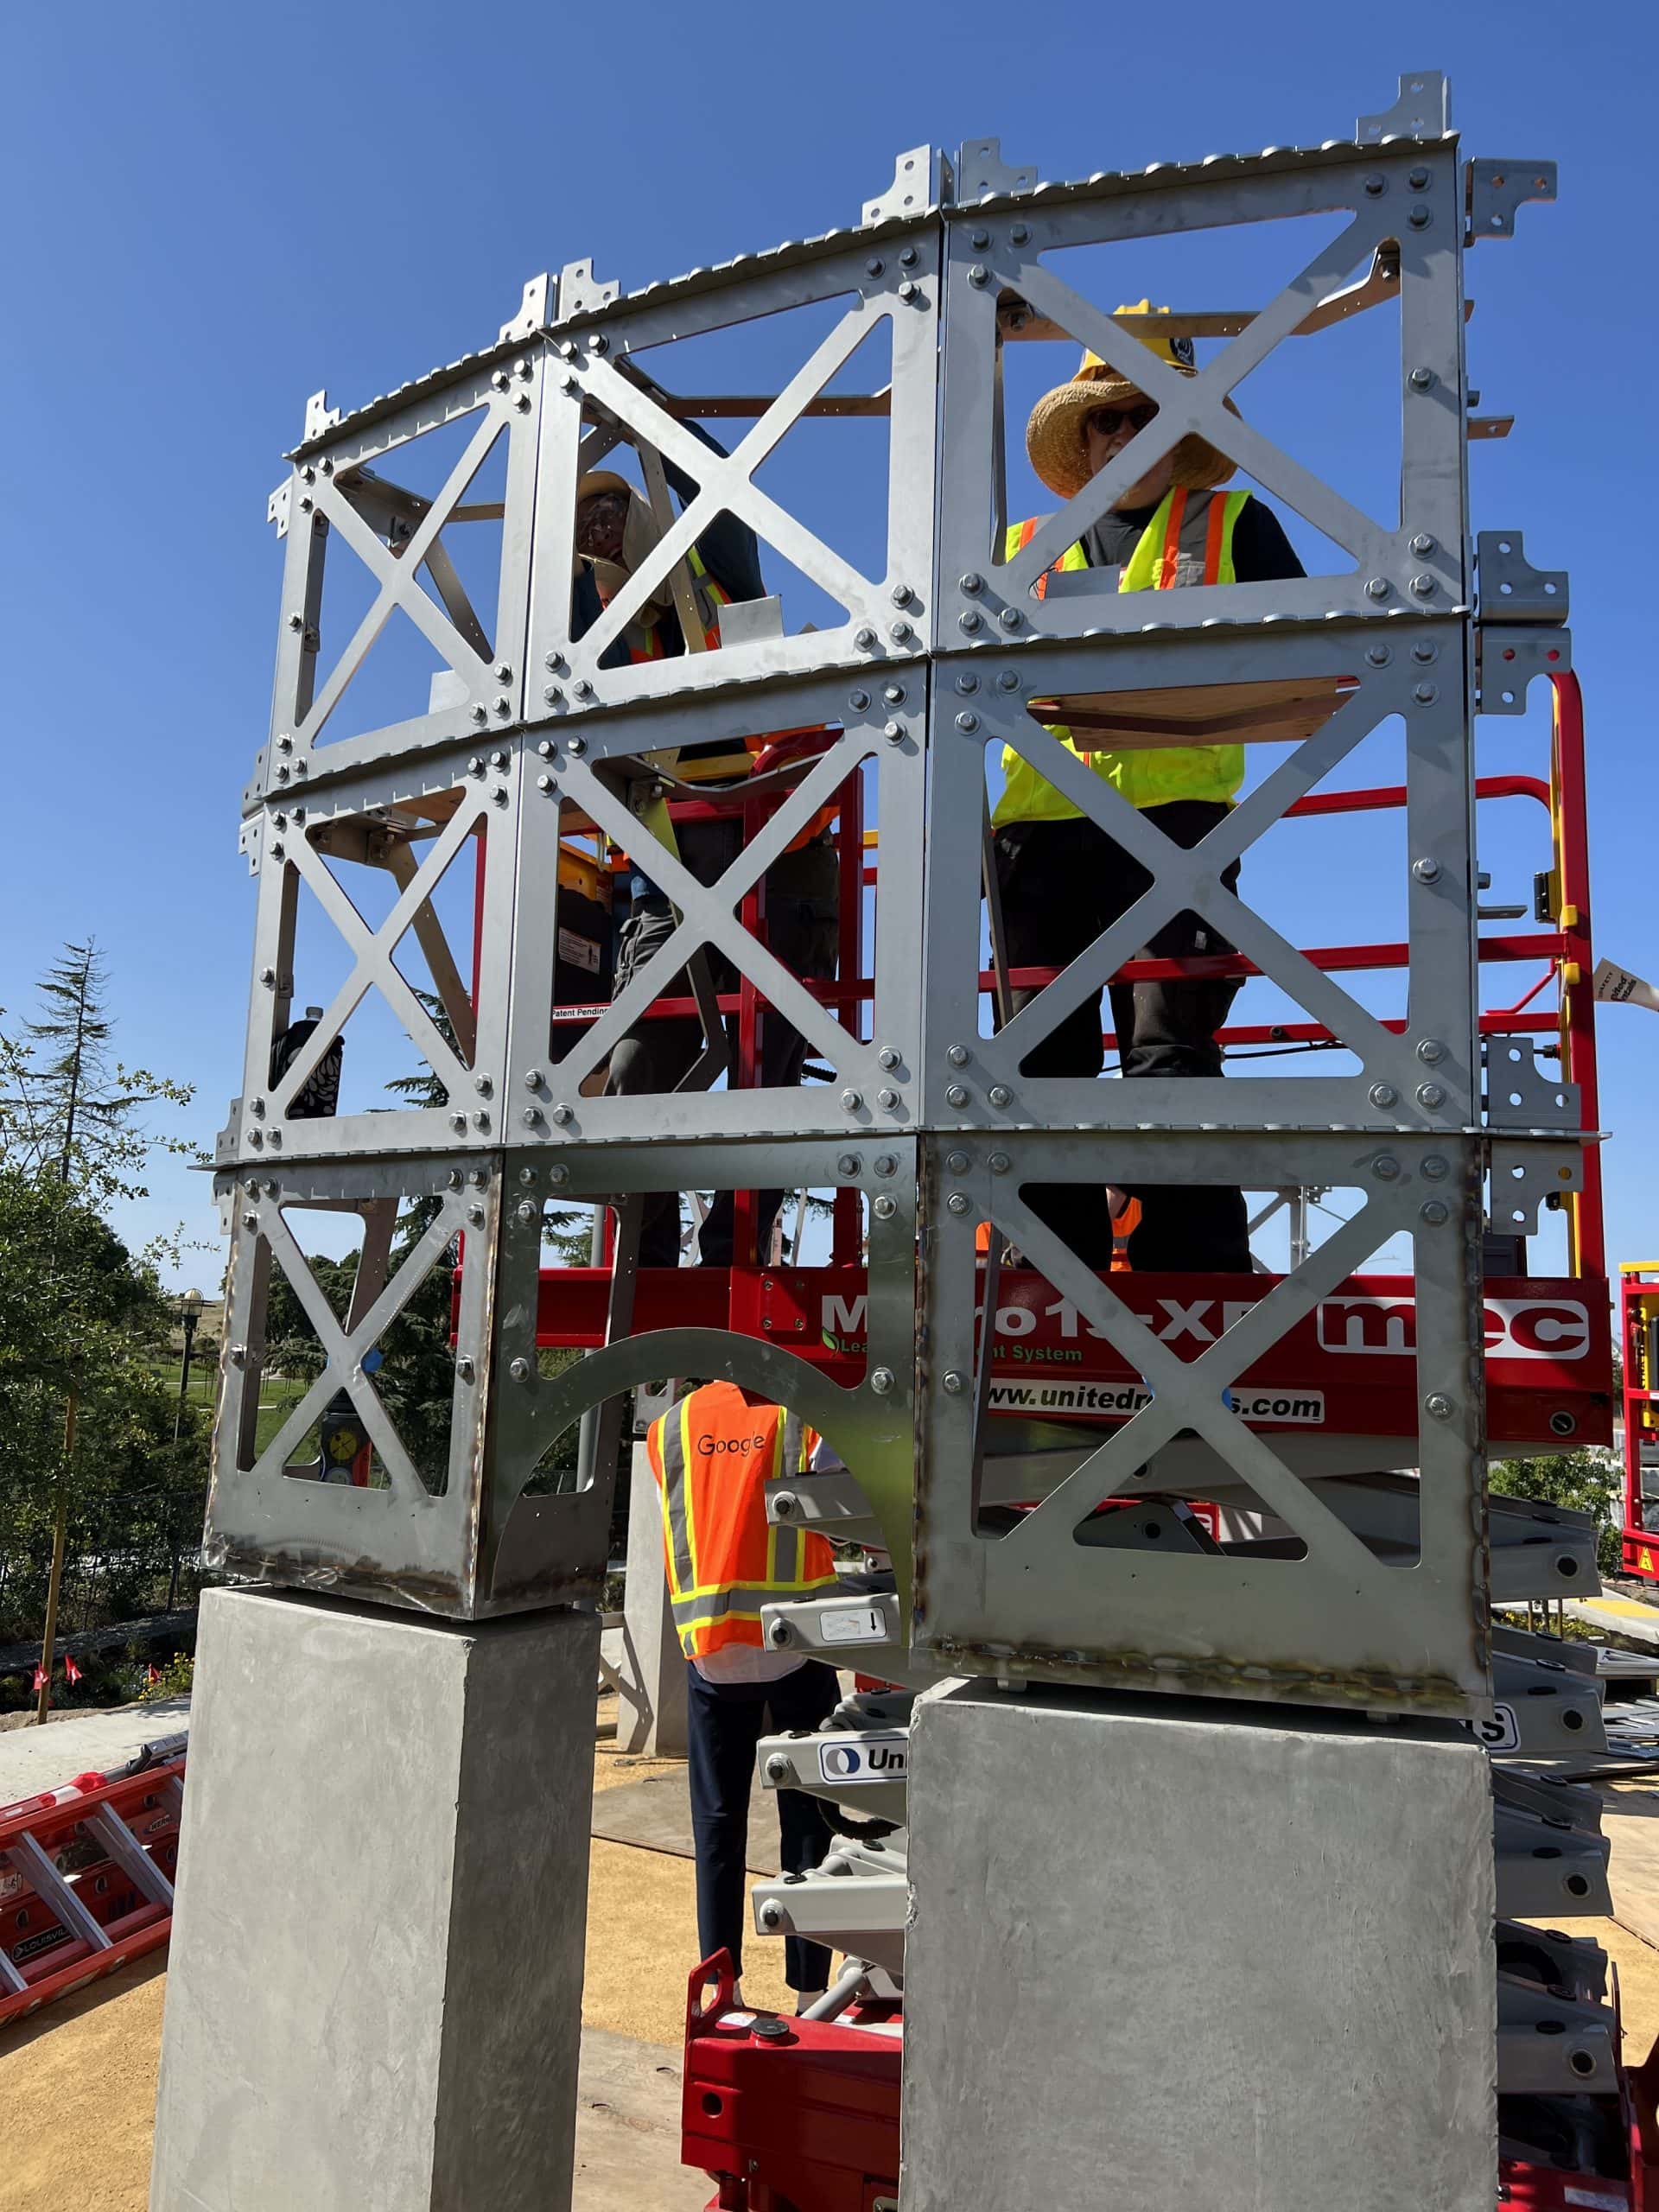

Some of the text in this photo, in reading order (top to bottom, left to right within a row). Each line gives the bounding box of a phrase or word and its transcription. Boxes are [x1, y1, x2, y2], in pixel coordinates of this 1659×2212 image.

[1323, 1303, 1586, 1352] mc
[1013, 1345, 1083, 1363] System
[697, 1431, 765, 1456] Google
